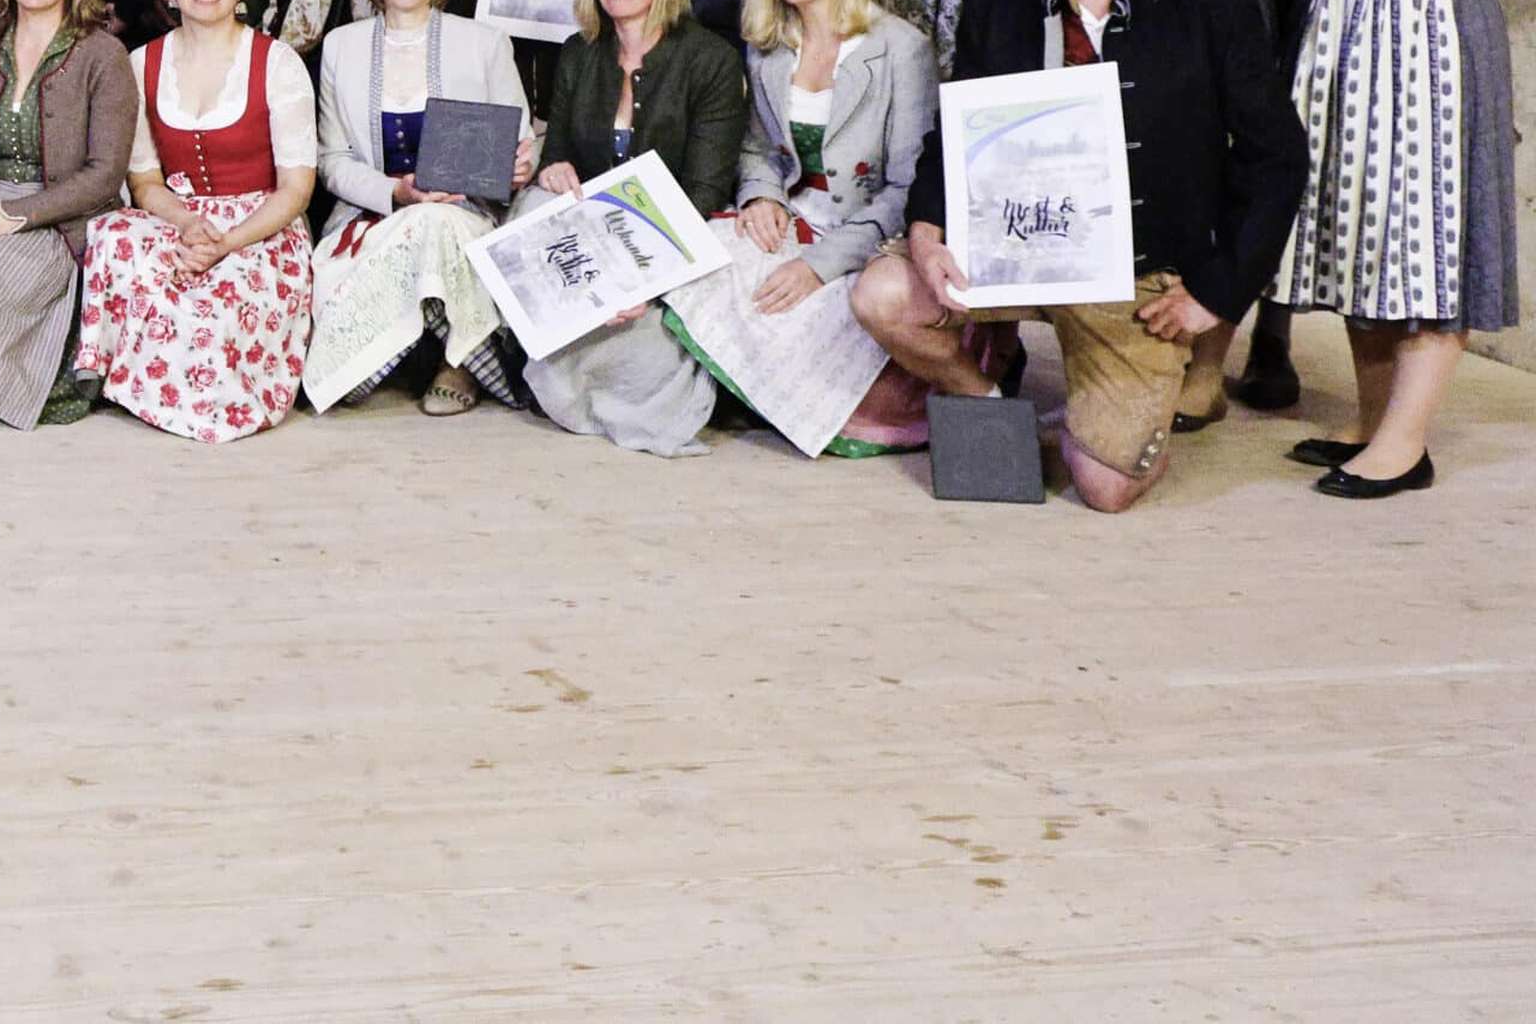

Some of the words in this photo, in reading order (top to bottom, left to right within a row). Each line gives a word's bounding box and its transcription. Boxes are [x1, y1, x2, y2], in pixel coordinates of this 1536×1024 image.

[1059, 196, 1076, 214] &
[604, 208, 654, 268] Urkunde
[583, 269, 601, 284] &
